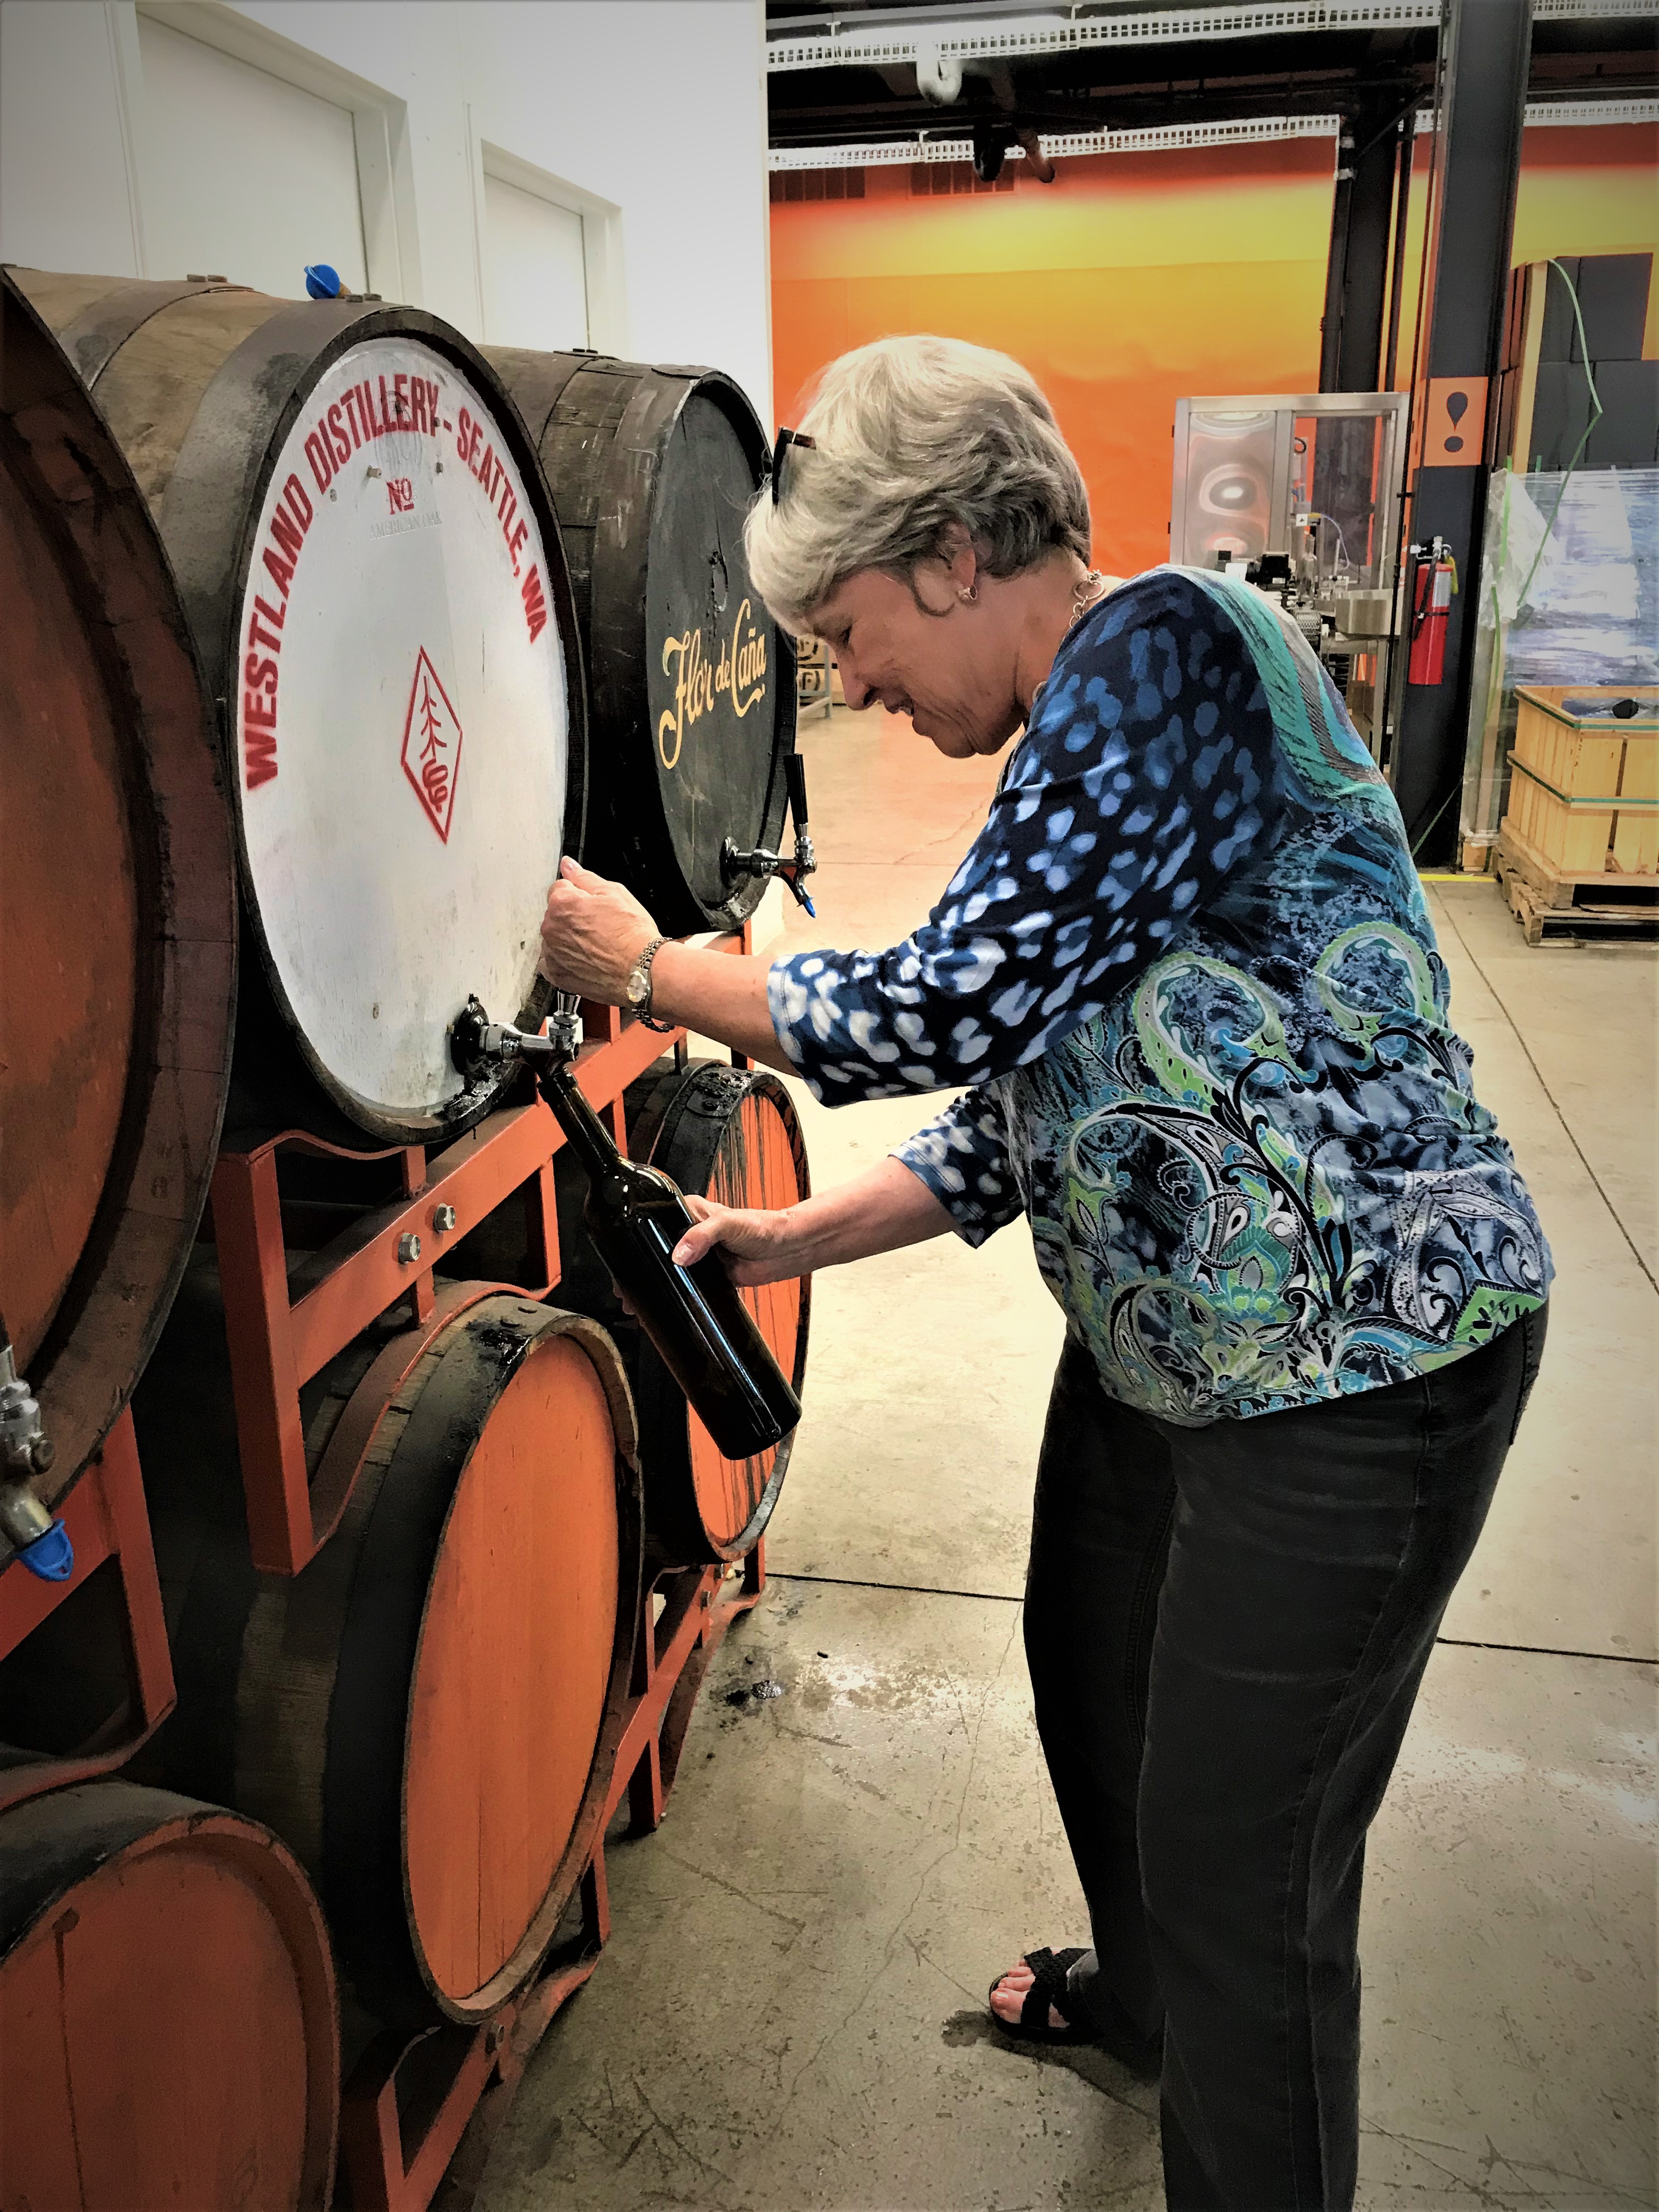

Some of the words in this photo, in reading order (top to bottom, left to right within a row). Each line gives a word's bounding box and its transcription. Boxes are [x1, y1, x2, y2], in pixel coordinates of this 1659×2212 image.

[245, 473, 314, 791] WESTLAND
[303, 374, 439, 493] DISTILLERY
[457, 406, 528, 578] SEATTLE,
[522, 562, 546, 644] WA
[370, 514, 420, 540] AMERICAN
[422, 511, 443, 528] OAK
[659, 627, 714, 770] Flor
[715, 639, 731, 692] de
[731, 598, 767, 718] Caña
